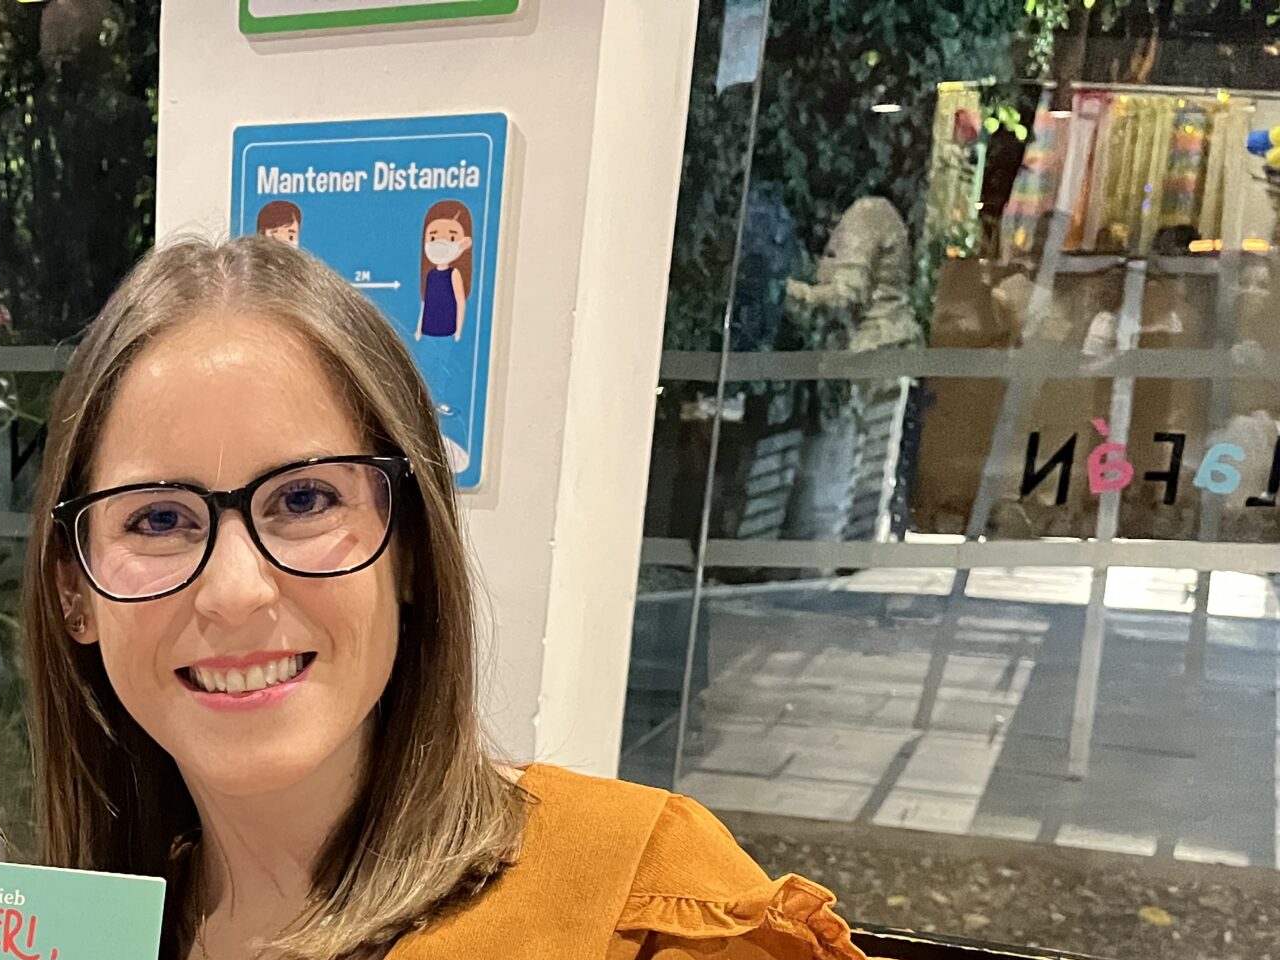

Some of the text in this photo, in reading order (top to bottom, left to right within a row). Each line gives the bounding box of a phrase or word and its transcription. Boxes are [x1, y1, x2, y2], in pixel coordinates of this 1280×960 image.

[257, 159, 480, 194] Mantener Distancia
[354, 270, 371, 281] 2M
